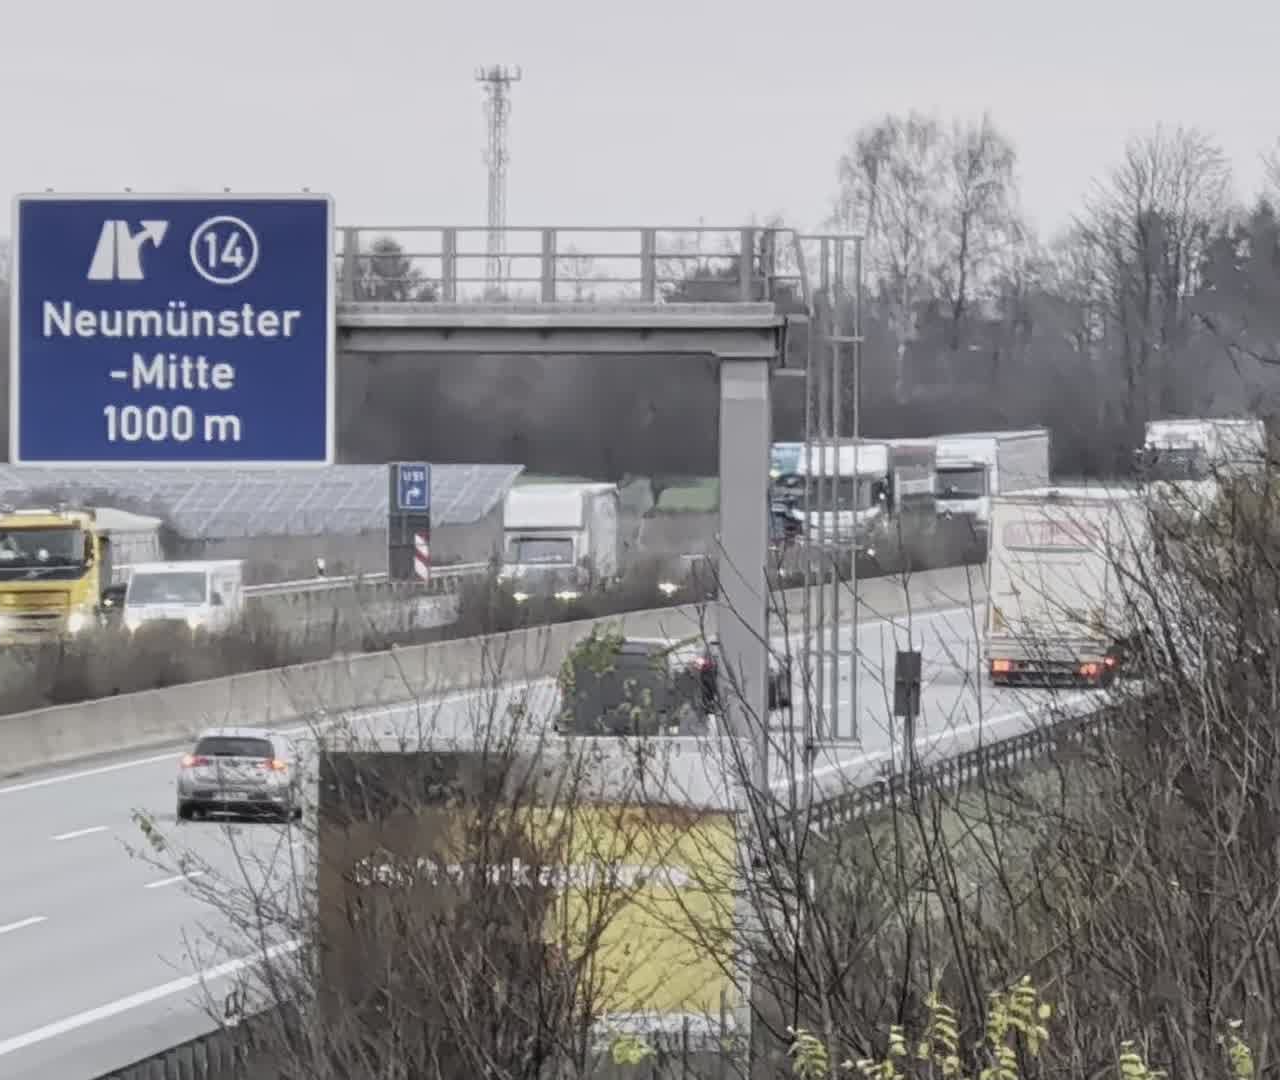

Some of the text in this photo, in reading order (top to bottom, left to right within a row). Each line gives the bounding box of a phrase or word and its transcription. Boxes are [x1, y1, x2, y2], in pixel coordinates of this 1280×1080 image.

[204, 232, 243, 268] 14
[43, 301, 301, 337] Neumünster
[110, 353, 235, 390] -Mitte
[103, 405, 241, 441] 1000 m
